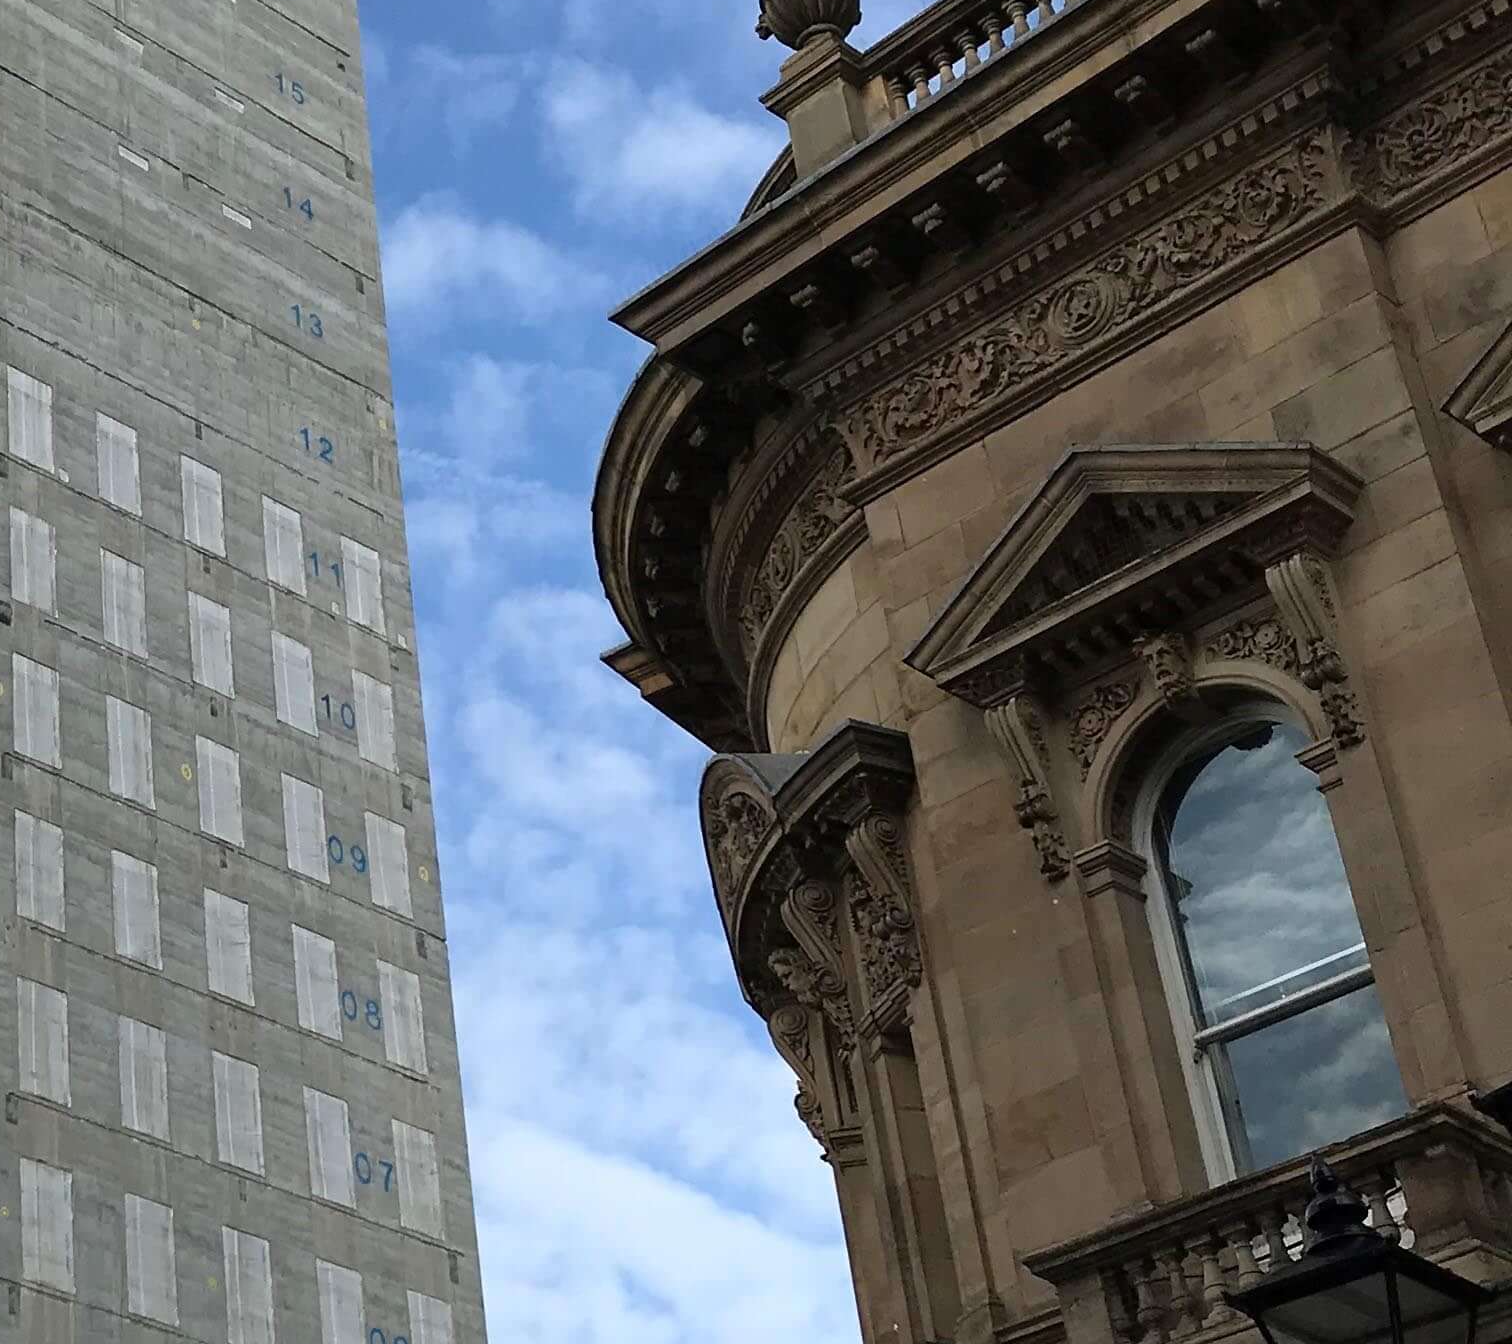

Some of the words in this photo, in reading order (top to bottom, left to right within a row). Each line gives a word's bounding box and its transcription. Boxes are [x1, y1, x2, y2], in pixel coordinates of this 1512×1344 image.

[274, 73, 305, 105] 15
[283, 186, 314, 220] 14
[291, 304, 324, 339] 13
[299, 428, 335, 463] 12
[309, 552, 342, 588] 11
[321, 694, 355, 729] 10
[327, 835, 367, 872] 09
[341, 991, 383, 1030] 08
[355, 1153, 394, 1192] 07
